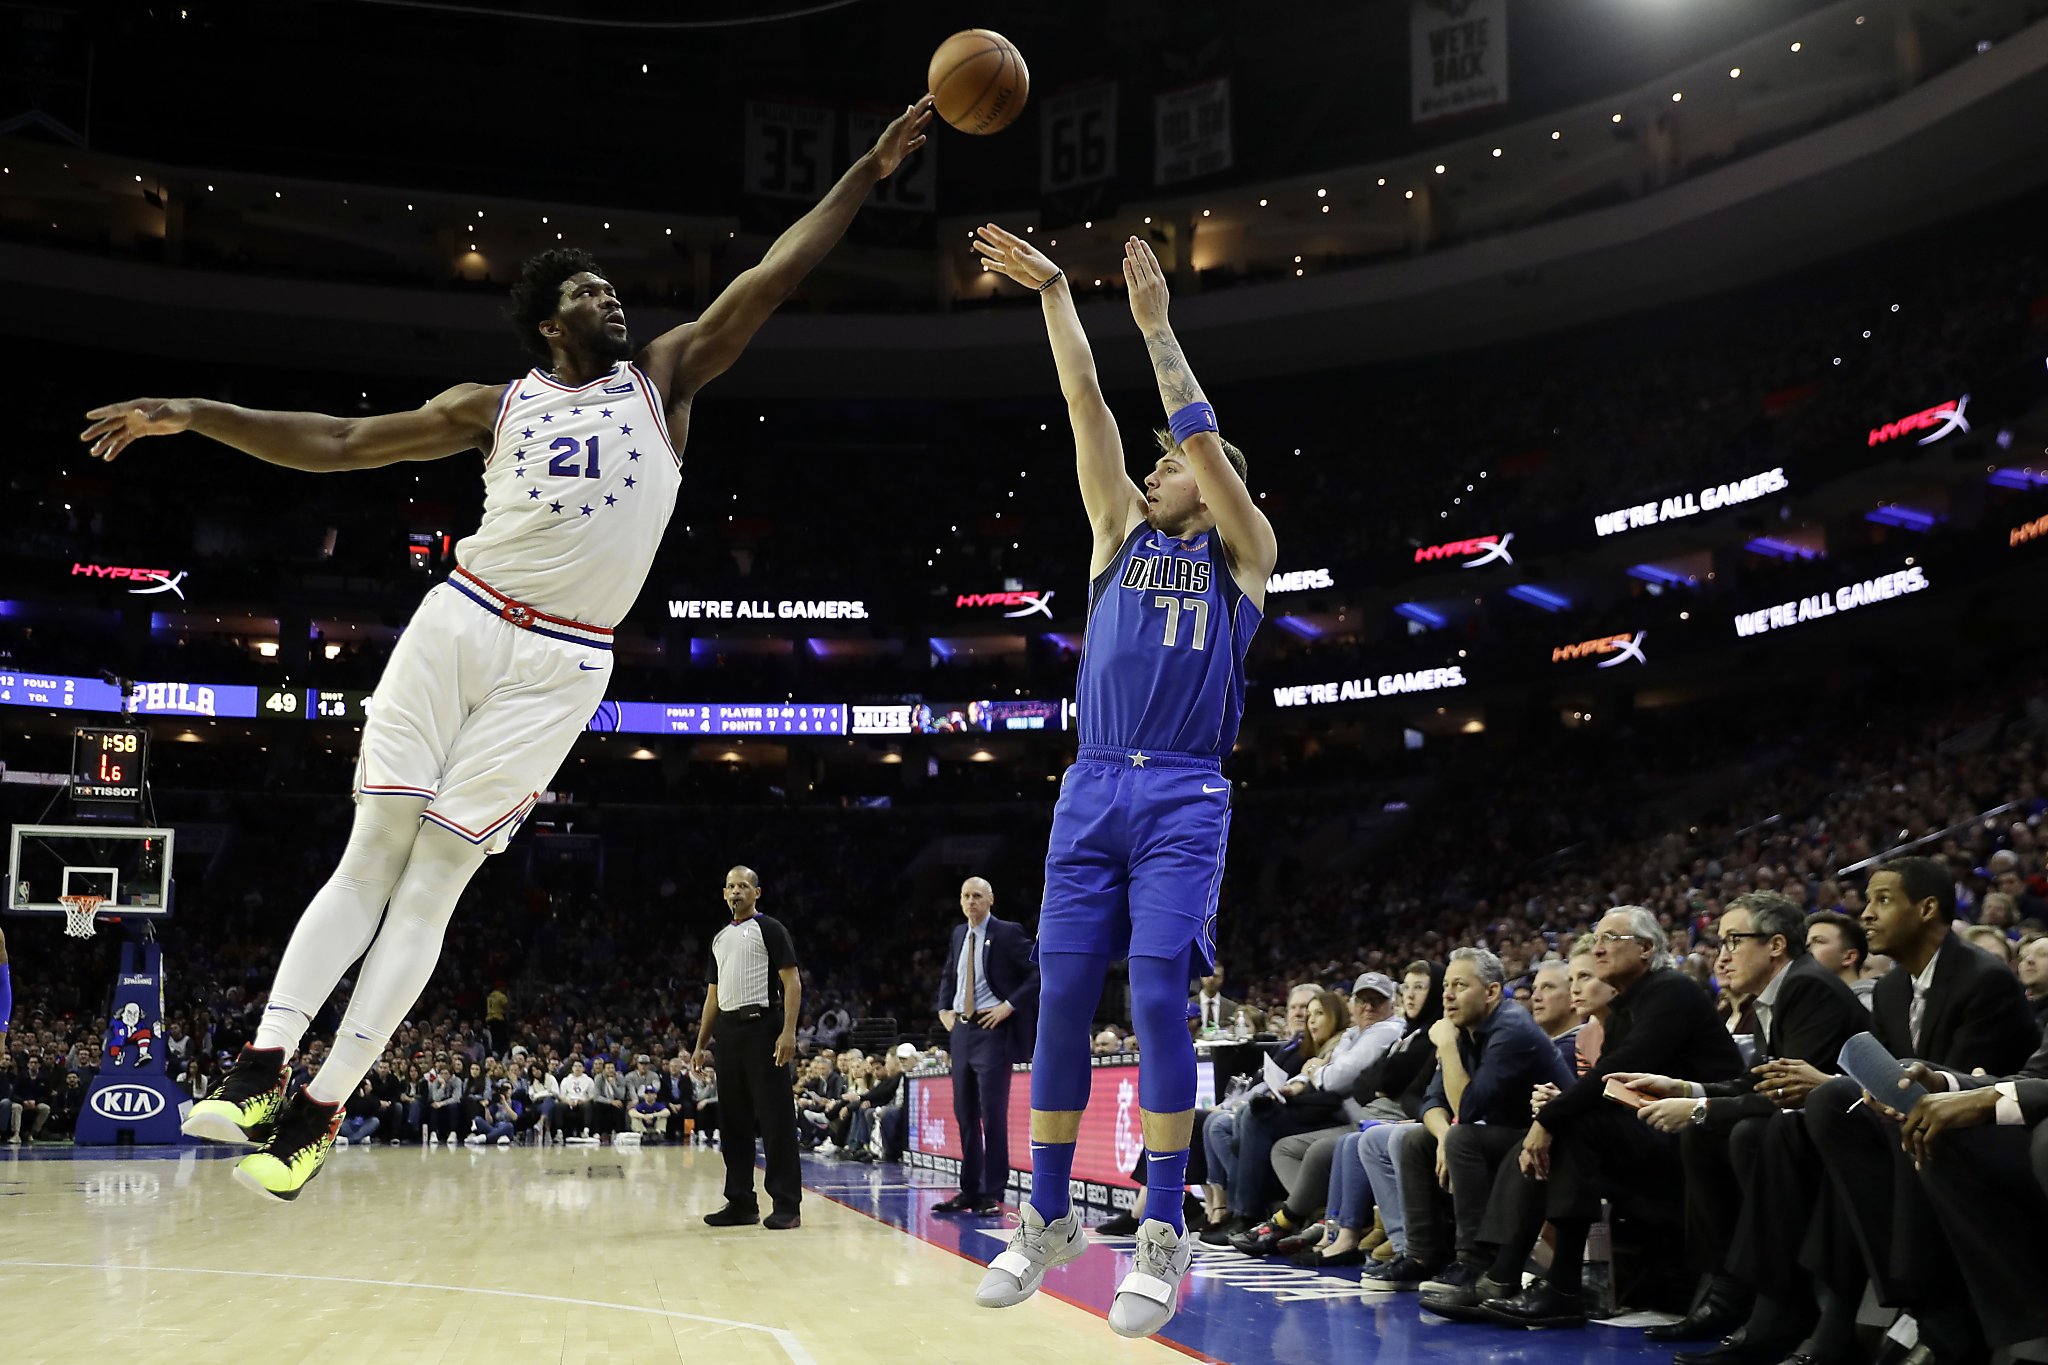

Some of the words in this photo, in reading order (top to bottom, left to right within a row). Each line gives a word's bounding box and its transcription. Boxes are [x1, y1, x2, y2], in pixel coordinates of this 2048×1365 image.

[1051, 110, 1106, 183] 66
[760, 123, 820, 193] 35
[549, 435, 601, 479] 21
[1594, 502, 1659, 536] WE'RE
[1659, 493, 1700, 521] ALL
[1700, 467, 1789, 511] GAMERS.
[1121, 556, 1211, 593] DALLAS
[1261, 568, 1334, 593] AMERS.
[668, 600, 734, 619] WE'RE
[736, 600, 775, 619] ALL
[778, 600, 869, 619] GAMERS.
[1734, 601, 1797, 637] WE'RE
[1798, 592, 1836, 622] ALL
[1836, 566, 1929, 611] GAMERS.
[1155, 596, 1208, 650] 77
[23, 679, 57, 689] FOULS
[64, 680, 75, 692] 2
[1273, 682, 1339, 707] WE'RE
[1340, 678, 1377, 701] ALL
[1378, 666, 1467, 696] GAMERS.
[28, 693, 49, 703] TOL
[63, 693, 74, 706] 5
[128, 683, 216, 717] PHILA
[265, 692, 298, 713] 49
[320, 692, 343, 701] SHOT
[318, 701, 346, 717] 1.8
[701, 706, 710, 719] 2
[720, 708, 762, 719] PLAYER
[812, 708, 826, 718] 77
[831, 708, 838, 718] 1
[853, 711, 910, 728] MUSE
[700, 720, 710, 732] 4
[722, 721, 762, 731] POINTS
[769, 721, 777, 731] 7
[102, 734, 137, 752] 1:58
[93, 787, 139, 797] TISSOT
[103, 1091, 152, 1112] KIA
